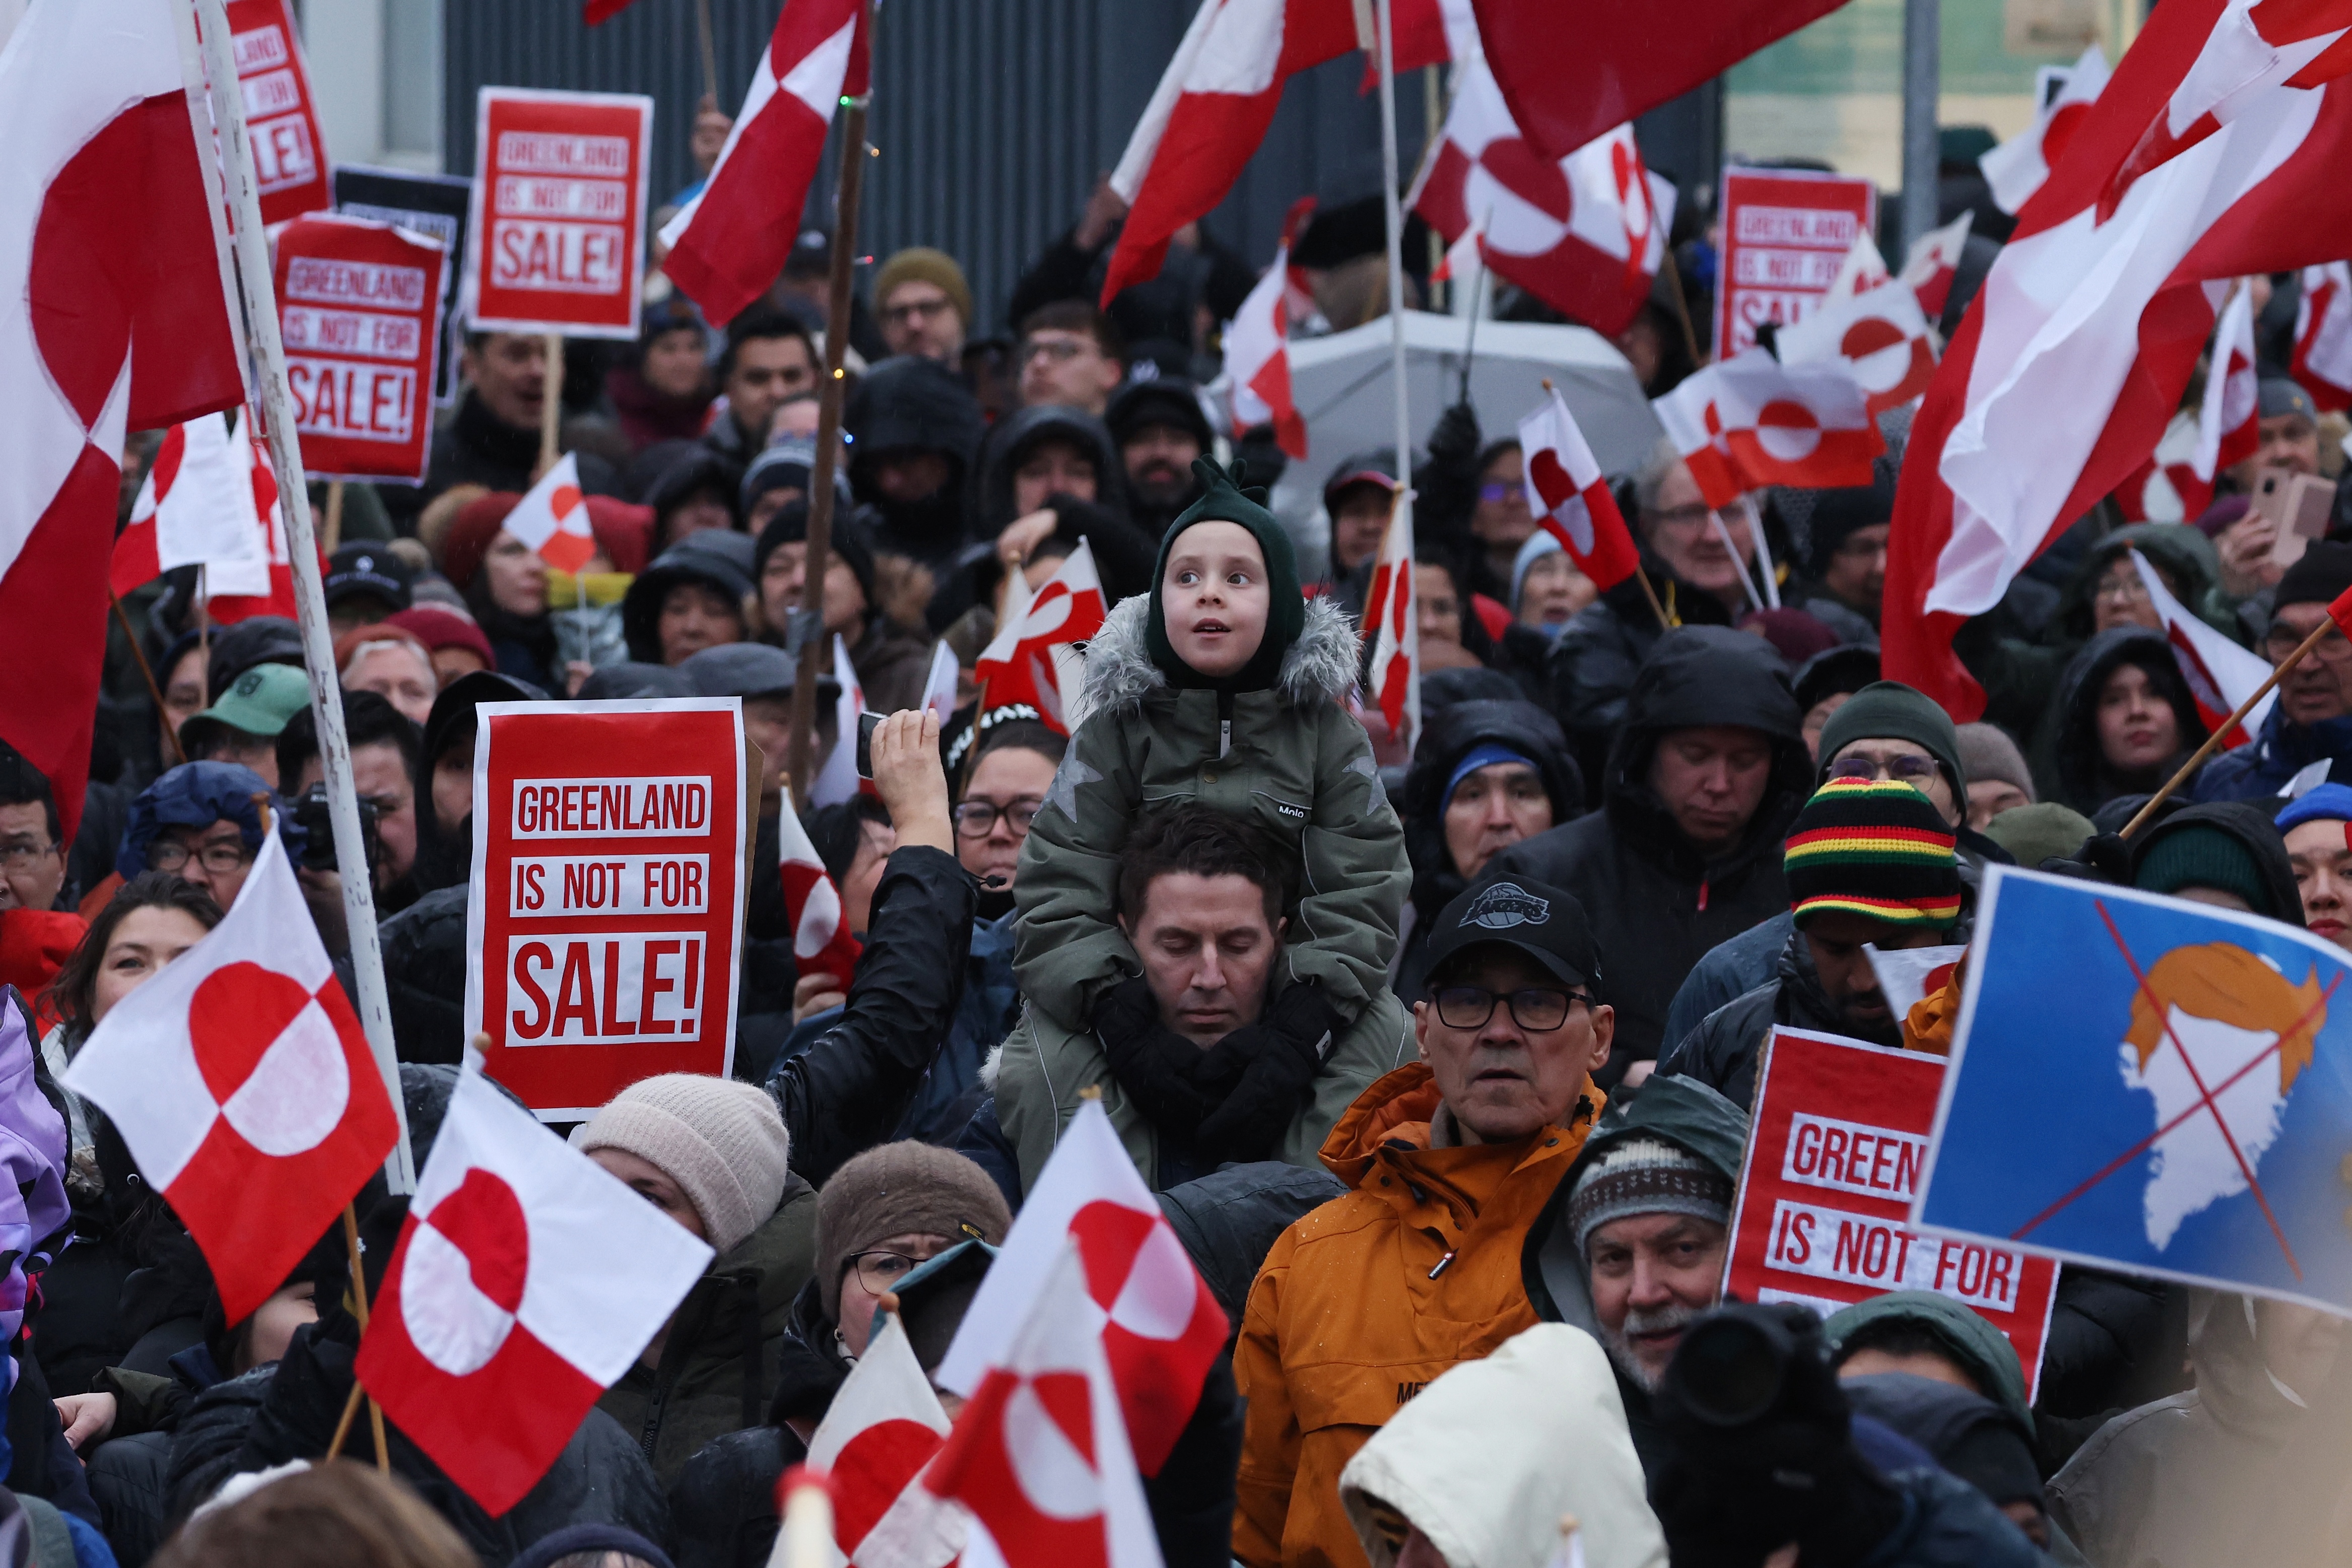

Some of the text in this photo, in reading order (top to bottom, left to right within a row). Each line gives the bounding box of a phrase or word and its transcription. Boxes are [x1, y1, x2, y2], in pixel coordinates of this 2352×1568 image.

[250, 123, 309, 185] LE!
[292, 262, 421, 304] GREENLAND
[497, 226, 619, 288] SALE!
[319, 314, 361, 349] NOT
[372, 319, 415, 354] FOR
[288, 364, 410, 435] SALE!
[518, 783, 705, 833] GREENLAND
[1279, 805, 1304, 819] Molo
[516, 860, 702, 910] IS NOT FOR
[512, 939, 700, 1040] SALE!
[1792, 1123, 1927, 1196] GREEN
[1774, 1209, 2014, 1304] IS NOT FOR
